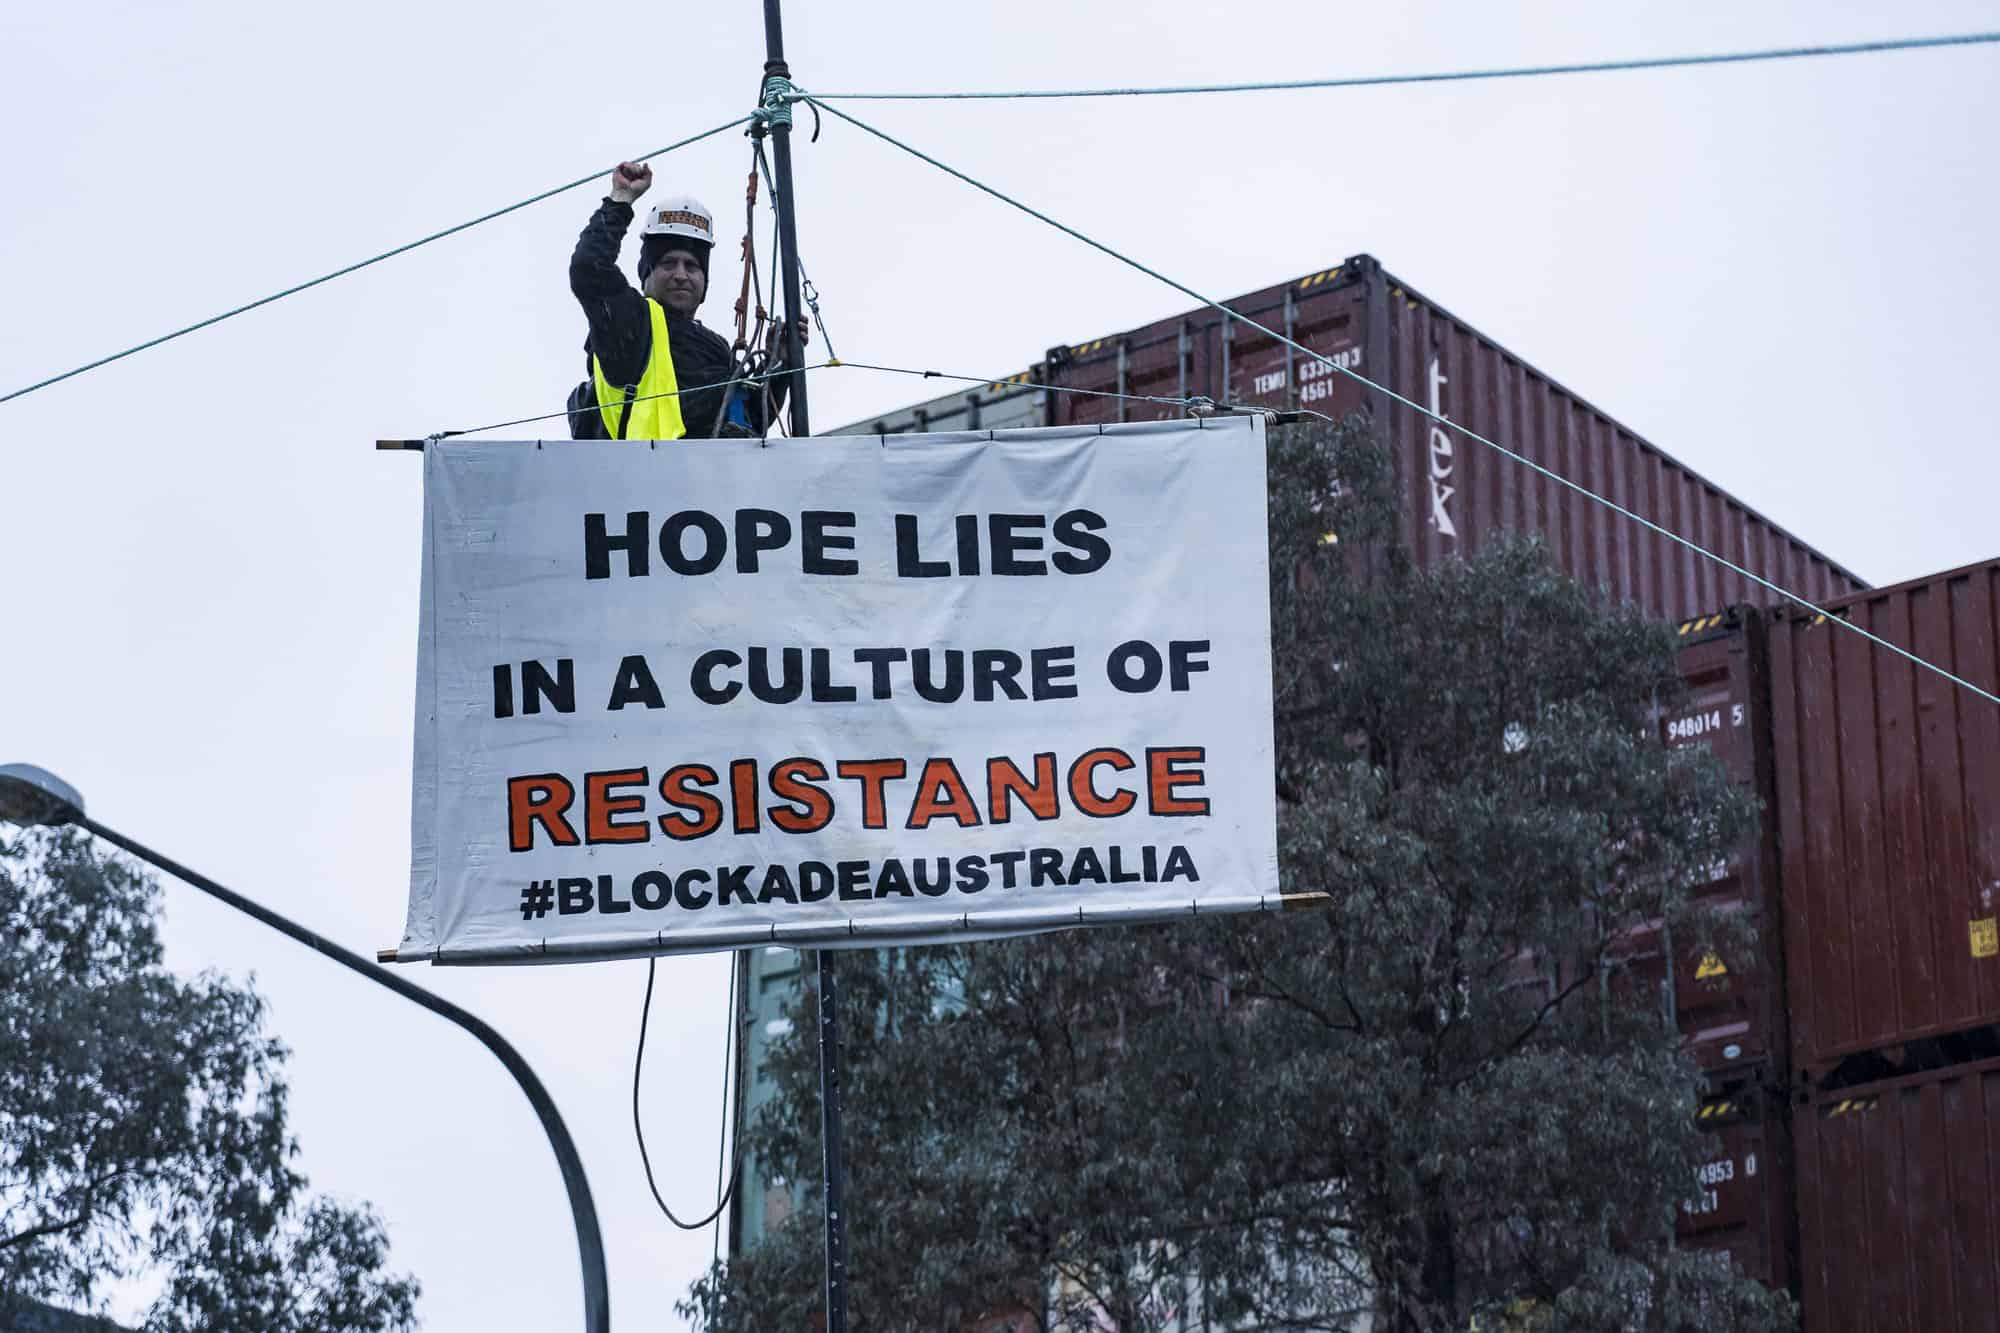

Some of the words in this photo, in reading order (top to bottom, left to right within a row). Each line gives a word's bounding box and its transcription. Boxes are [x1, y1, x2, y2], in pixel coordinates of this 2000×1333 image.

[585, 509, 858, 580] HOPE
[895, 509, 1111, 577] LIES
[493, 659, 575, 718] IN
[608, 655, 665, 710] A
[691, 646, 1077, 705] CULTURE
[1107, 640, 1209, 693] OF
[1668, 710, 1720, 740] 948014
[1731, 703, 1744, 727] 5
[507, 747, 1210, 853] RESISTANCE
[520, 846, 1199, 921] #BLOCKADEAUSTRALIA
[1693, 1160, 1733, 1184] 4953
